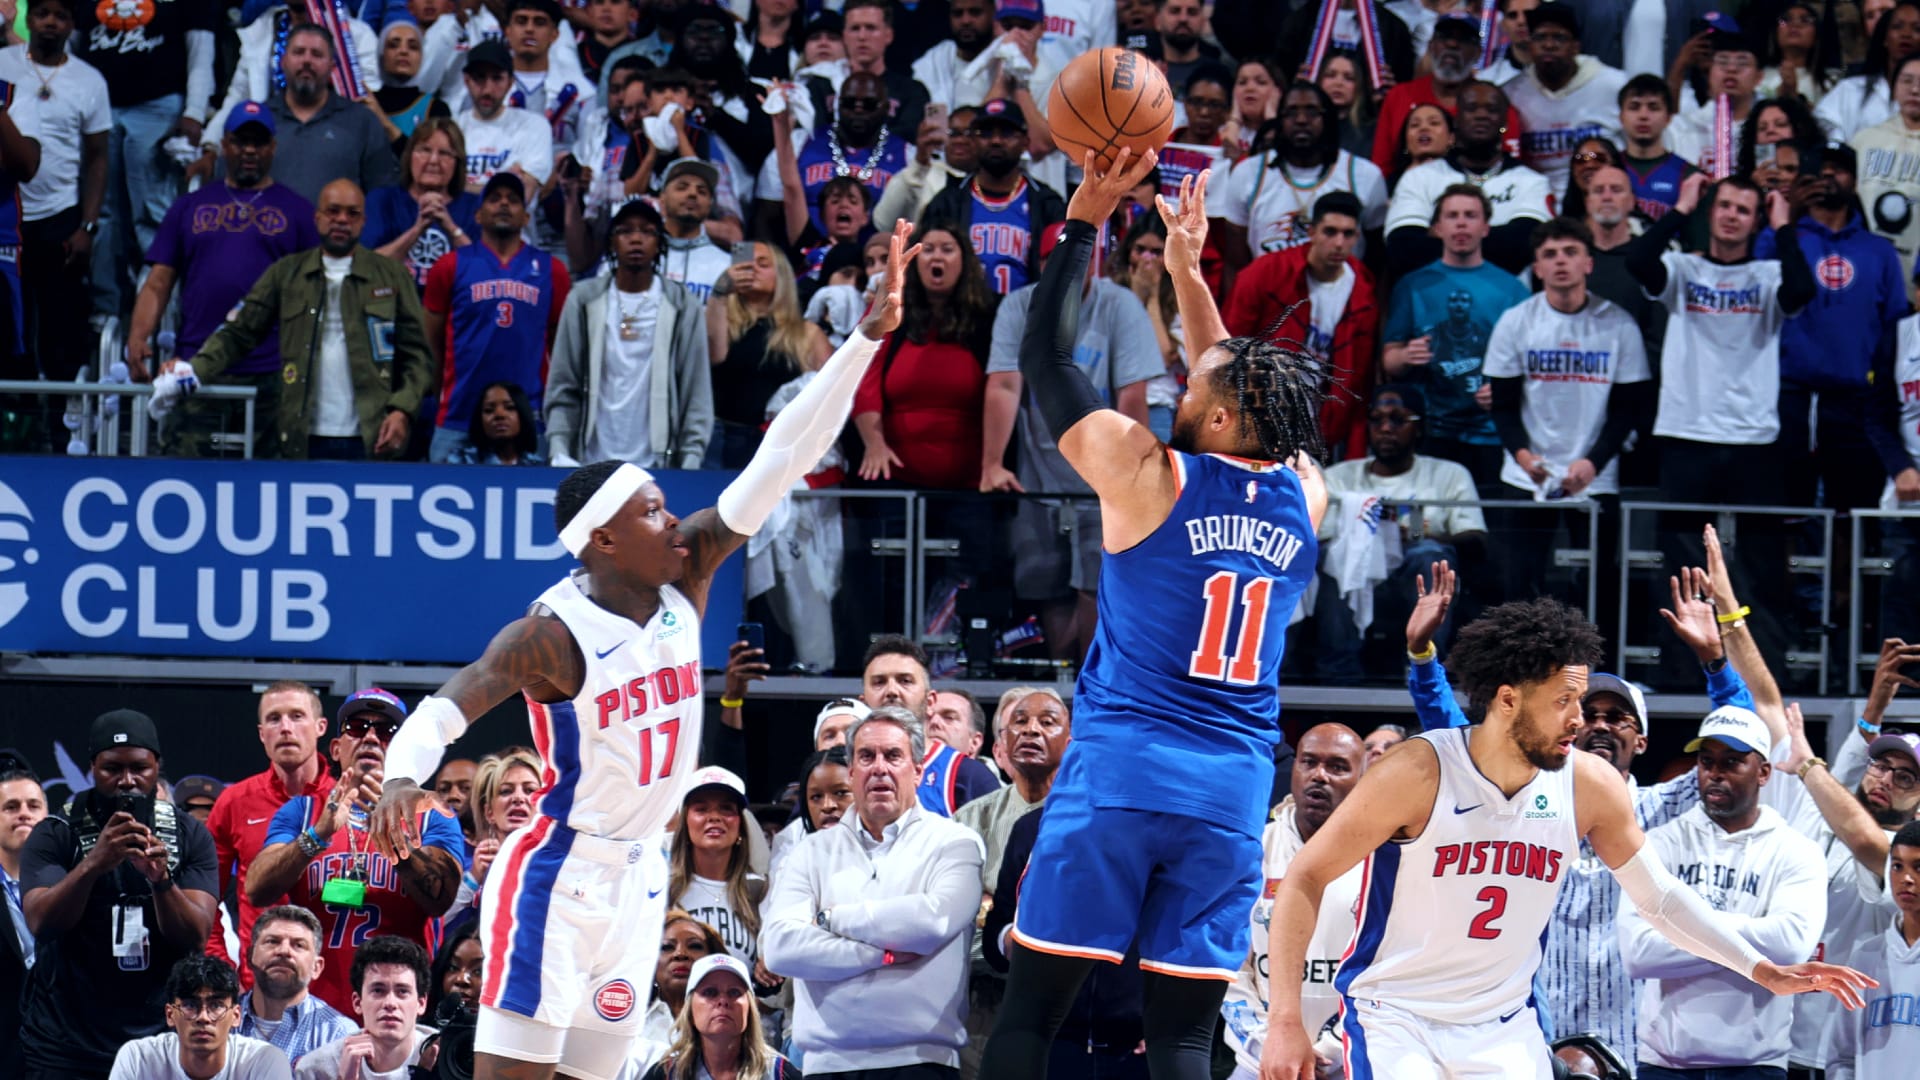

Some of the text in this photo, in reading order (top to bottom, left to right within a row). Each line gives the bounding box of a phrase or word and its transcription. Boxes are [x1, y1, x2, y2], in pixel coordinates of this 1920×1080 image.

[470, 278, 540, 306] DETROIT
[495, 301, 513, 328] 3
[62, 477, 568, 561] COURTSID
[1186, 514, 1303, 571] BRUNSON
[61, 563, 331, 642] CLUB
[1189, 571, 1273, 685] 11
[594, 660, 699, 730] PISTONS
[638, 717, 680, 787] 17
[1433, 840, 1564, 883] PISTONS
[326, 904, 380, 949] 72
[1467, 886, 1508, 939] 2
